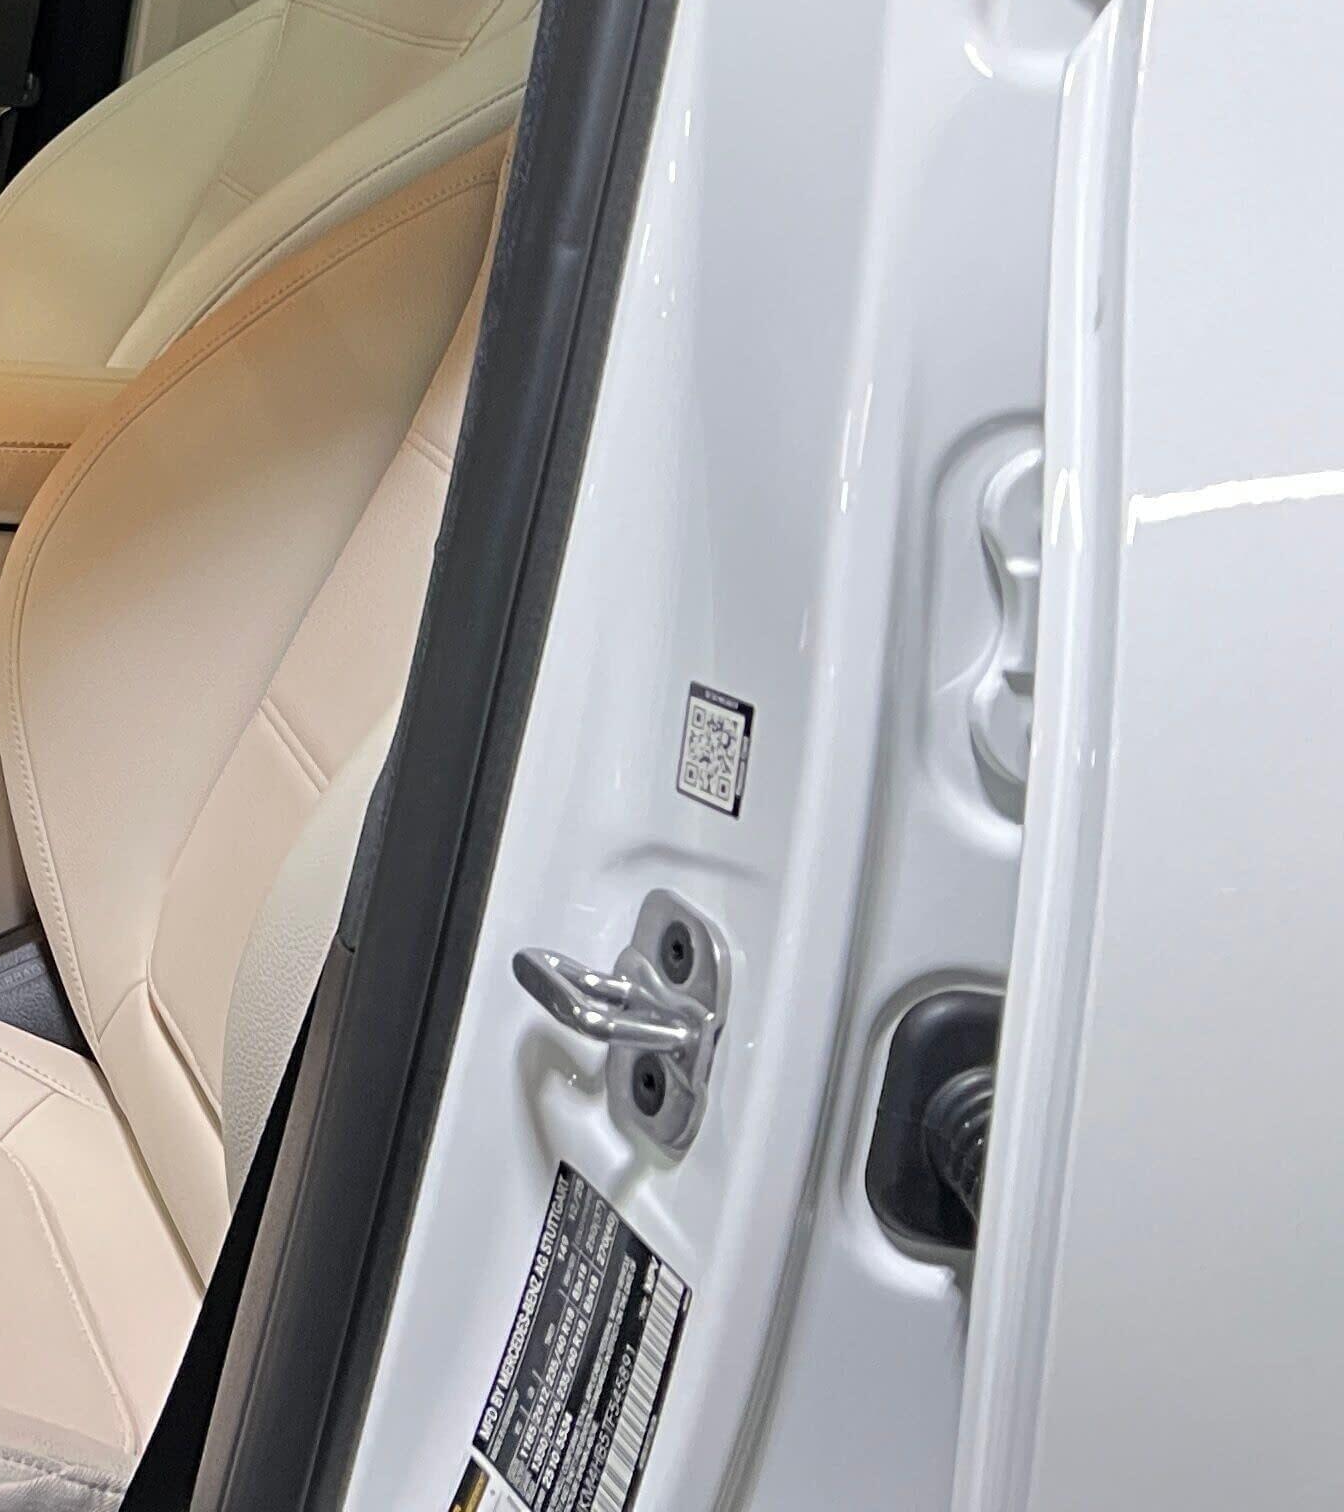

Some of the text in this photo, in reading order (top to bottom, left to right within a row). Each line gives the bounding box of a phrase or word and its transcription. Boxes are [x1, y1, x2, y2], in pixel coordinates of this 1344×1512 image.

[542, 1174, 571, 1256] STUTTGART
[535, 1251, 549, 1275] AG
[498, 1272, 542, 1387] MERCEDES-BENZ
[492, 1386, 505, 1409] BY
[532, 1385, 549, 1424] 2612
[480, 1404, 498, 1441] MFD
[543, 1449, 559, 1489] 2510
